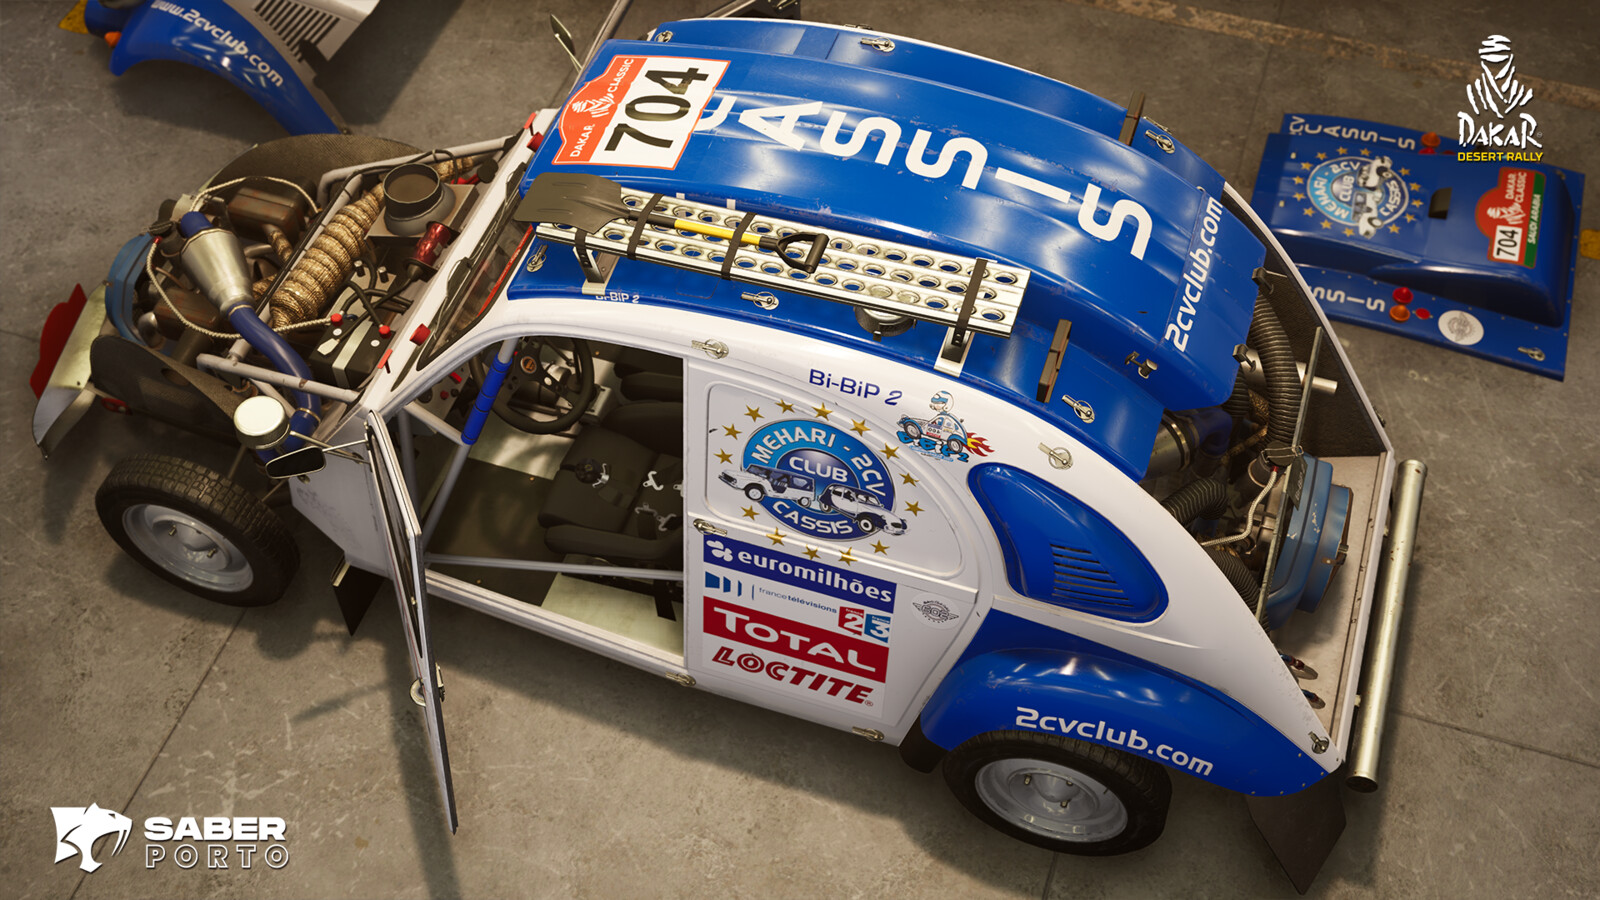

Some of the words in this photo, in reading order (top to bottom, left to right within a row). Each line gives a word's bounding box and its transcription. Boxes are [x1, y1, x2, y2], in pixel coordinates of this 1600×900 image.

[608, 58, 635, 93] CLASSIC
[604, 67, 710, 152] 704
[570, 124, 596, 158] DAKAR
[1304, 124, 1416, 150] CASSIS
[1314, 176, 1350, 219] MEHARI
[1339, 175, 1355, 202] CLUB
[1505, 172, 1517, 200] DAKAR
[1514, 171, 1527, 203] CLASSIC
[1496, 229, 1519, 257] 704
[1164, 196, 1224, 353] 2cvclub.com
[631, 294, 640, 304] 2
[808, 368, 881, 399] Bi-BiP
[884, 390, 903, 406] 2
[751, 426, 837, 464] MEHARI
[850, 453, 886, 497] 2CV
[788, 456, 849, 483] CLUB
[772, 501, 853, 535] CASSIS
[738, 550, 892, 602] euromilhões
[843, 612, 864, 632] 2
[870, 620, 890, 638] 3
[713, 606, 876, 673] TOTAL
[712, 646, 874, 704] LOCTITE
[1015, 706, 1214, 776] 2cvclub.com
